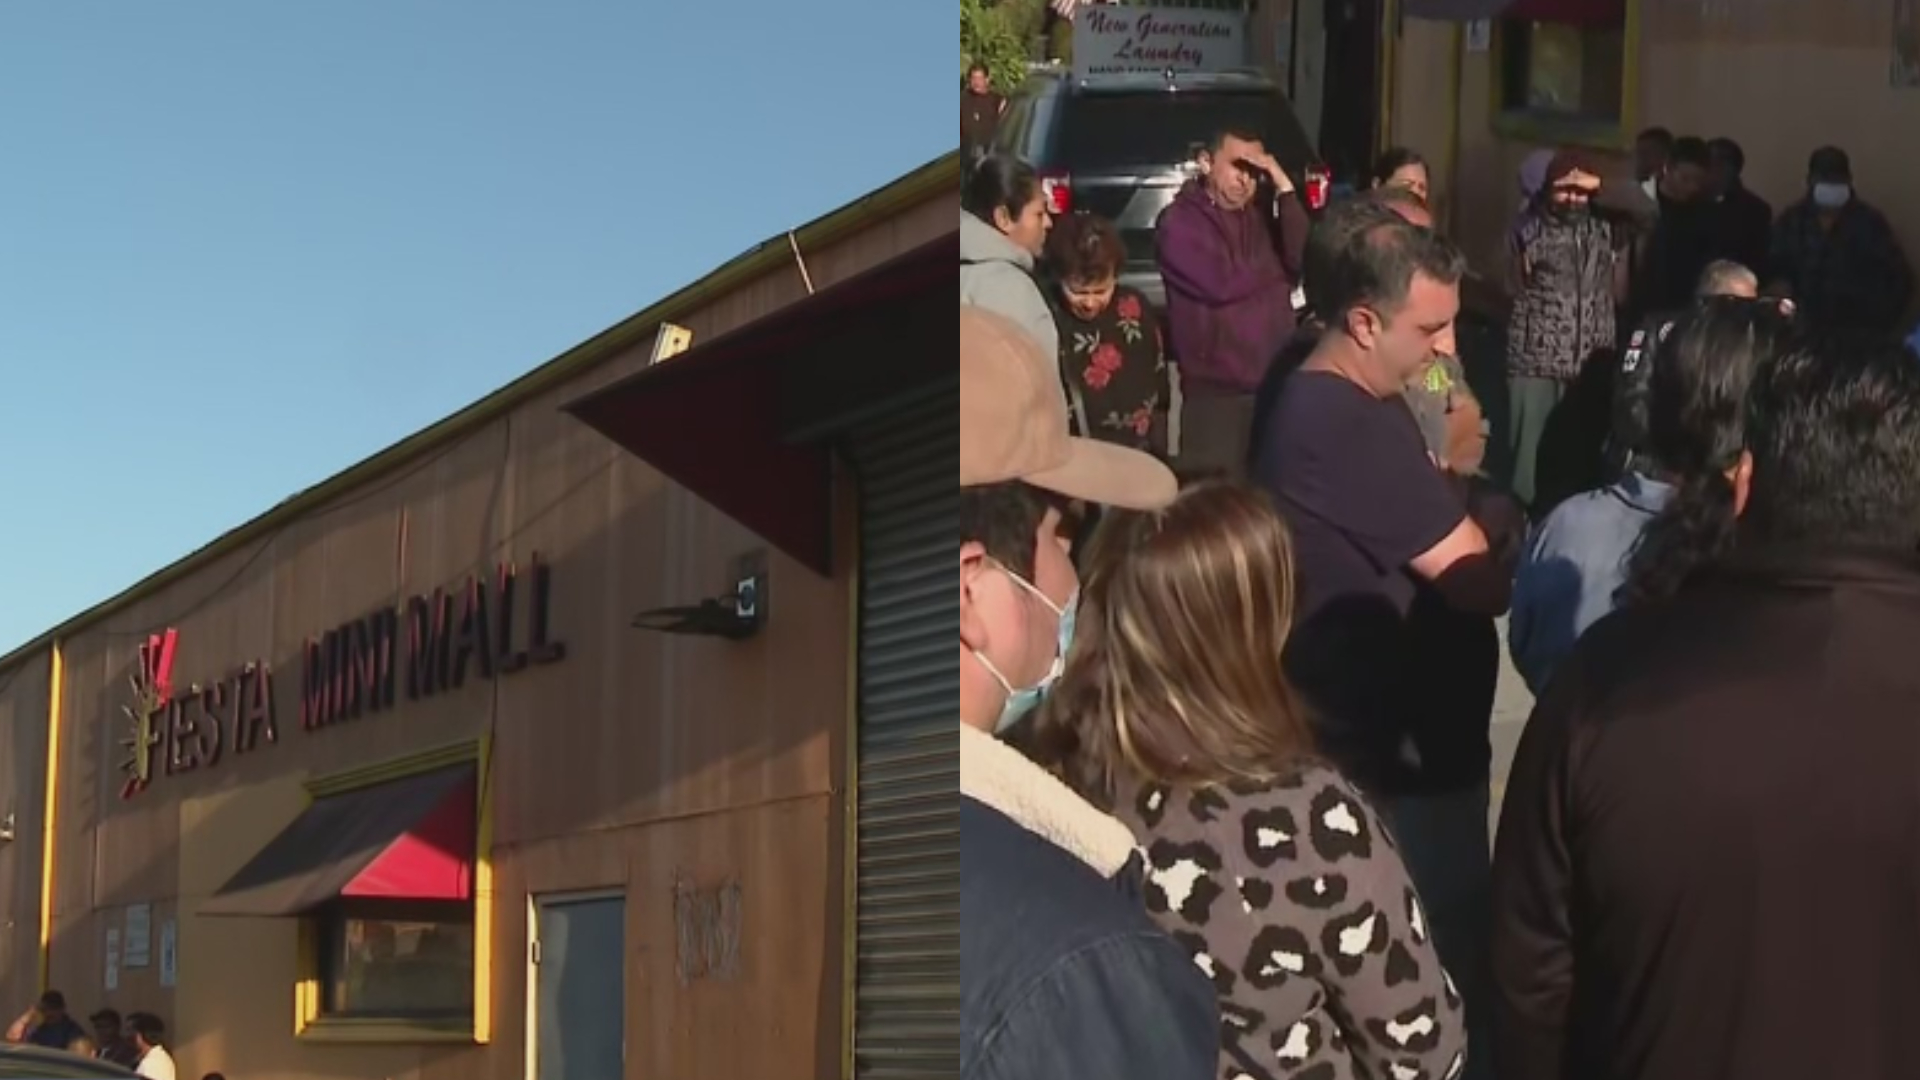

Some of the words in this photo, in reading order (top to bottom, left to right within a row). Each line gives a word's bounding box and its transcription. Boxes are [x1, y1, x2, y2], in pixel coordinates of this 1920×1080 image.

[1086, 9, 1128, 34] New
[1136, 13, 1232, 41] Generation
[1113, 38, 1203, 66] Laundry
[135, 658, 280, 783] FIESTA
[301, 605, 401, 732] MINI
[407, 552, 567, 700] MALL
